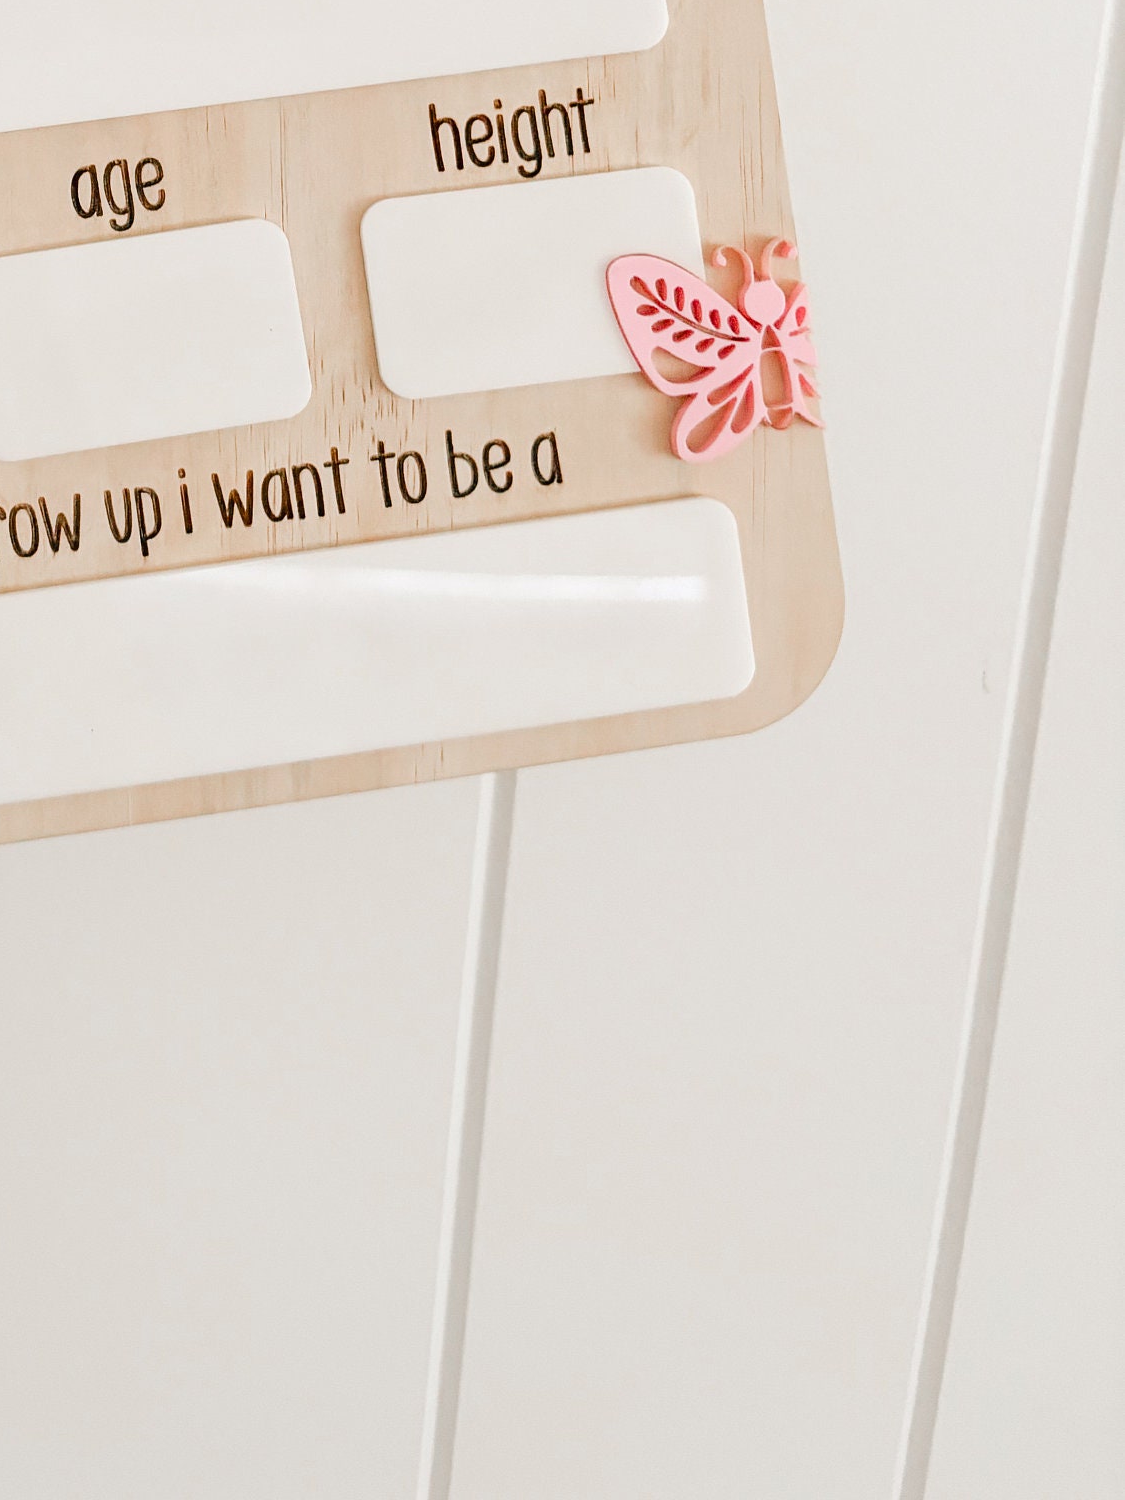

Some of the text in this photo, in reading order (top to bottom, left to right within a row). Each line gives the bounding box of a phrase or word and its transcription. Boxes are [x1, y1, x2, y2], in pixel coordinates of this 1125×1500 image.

[428, 87, 595, 179] height
[70, 157, 166, 232] age
[104, 487, 162, 558] up
[177, 467, 194, 535] i
[211, 447, 350, 529] want
[369, 440, 428, 509] to
[445, 429, 514, 499] be
[530, 431, 564, 487] a
